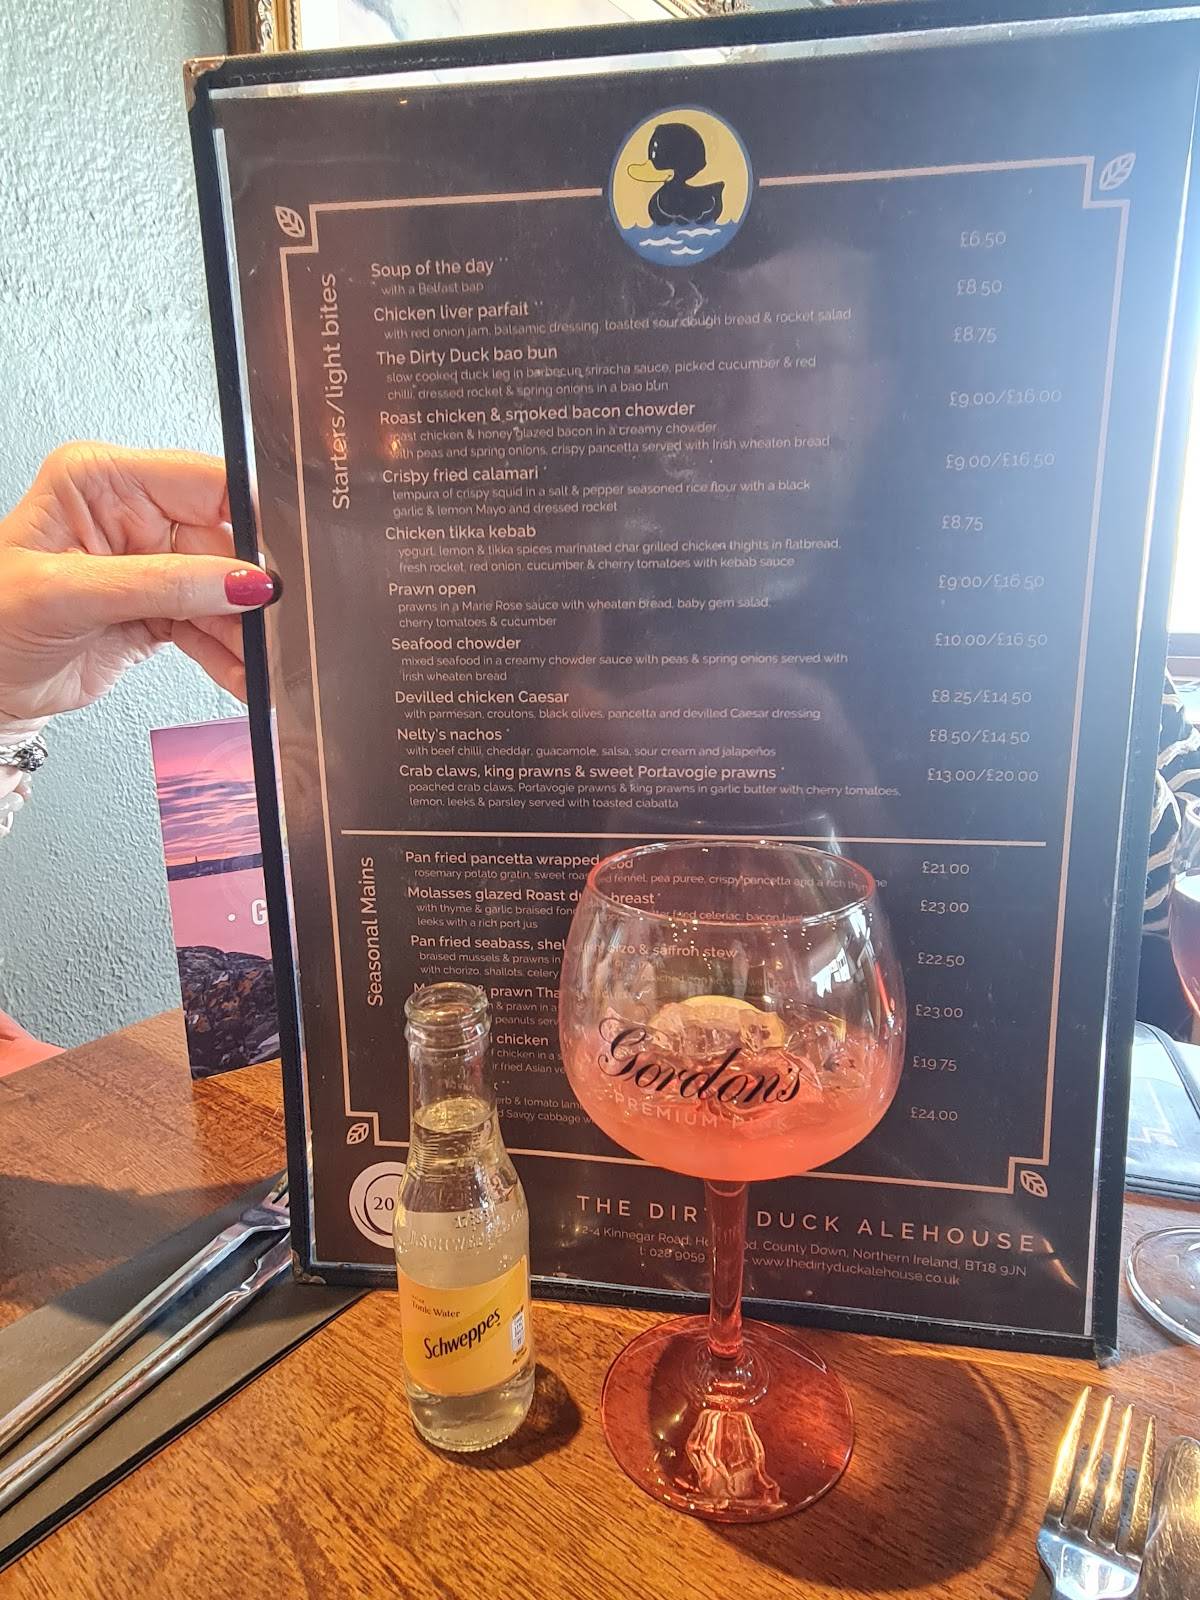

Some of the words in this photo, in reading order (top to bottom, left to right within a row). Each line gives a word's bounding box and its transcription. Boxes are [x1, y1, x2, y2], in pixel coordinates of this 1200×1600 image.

[371, 262, 411, 279] Soup
[415, 260, 430, 275] of
[435, 259, 461, 274] the
[465, 258, 494, 276] day
[381, 284, 405, 296] with
[408, 286, 415, 294] a
[419, 282, 460, 295] Belfast
[462, 282, 484, 293] bap
[321, 273, 340, 336] bites
[374, 307, 435, 322] Chicken
[440, 304, 473, 320] liver
[478, 301, 529, 321] parfait
[376, 351, 406, 365] The
[410, 349, 445, 366] Dirty
[450, 348, 490, 363] Duck
[493, 347, 523, 361] bao
[527, 346, 558, 360] bun
[380, 411, 423, 424] Roast
[427, 408, 485, 424] chicken
[491, 408, 500, 421] &
[505, 406, 568, 421] smoked
[572, 404, 621, 419] bacon
[625, 402, 695, 417] chowder
[324, 342, 350, 509] Starters/light
[382, 469, 429, 485] Crispy
[433, 467, 468, 482] fried
[473, 465, 539, 482] calamari
[393, 503, 423, 518] garlic
[427, 505, 434, 515] &
[438, 503, 472, 515] lemon
[475, 503, 506, 516] Mayo
[509, 503, 531, 514] and
[533, 501, 578, 514] dressed
[581, 500, 618, 512] rocket
[385, 525, 445, 541] Chicken
[449, 524, 485, 539] tikka
[489, 523, 536, 538] kebab
[388, 583, 435, 596] Prawn
[438, 583, 476, 599] open
[399, 616, 433, 630] cherry
[436, 616, 487, 628] tomatoes
[489, 616, 498, 627] &
[500, 616, 556, 627] cucumber
[391, 637, 452, 651] Seafood
[457, 636, 521, 650] chowder
[402, 671, 424, 682] Irish
[426, 671, 472, 681] wheaten
[475, 671, 507, 681] bread
[395, 690, 454, 704] Devilled
[457, 690, 515, 703] chicken
[518, 690, 569, 704] Caesar
[405, 710, 426, 719] with
[539, 709, 567, 719] black
[610, 709, 656, 721] pancetta
[659, 708, 680, 719] and
[683, 708, 727, 719] devilled
[729, 708, 769, 719] Caesar
[772, 708, 821, 721] dressing
[397, 728, 446, 743] Nelty's
[450, 728, 502, 741] nachos
[399, 765, 433, 777] Crab
[436, 764, 481, 779] claws,
[484, 765, 514, 780] king
[518, 766, 571, 780] prawns
[575, 766, 585, 778] &
[590, 766, 634, 778] sweet
[638, 765, 718, 780] Portavogie
[721, 767, 777, 780] prawns
[408, 783, 455, 794] poached
[457, 783, 480, 792] crab
[518, 783, 574, 794] Portavogie
[577, 785, 617, 794] prawns
[620, 783, 627, 793] &
[630, 784, 653, 795] king
[656, 784, 695, 795] prawns
[698, 783, 708, 793] in
[710, 784, 740, 796] garlic
[743, 785, 777, 794] butter
[780, 785, 804, 795] with
[807, 785, 841, 797] cherry
[447, 797, 476, 807] leeks
[478, 797, 486, 807] &
[488, 797, 526, 809] parsley
[528, 798, 564, 807] served
[567, 798, 590, 807] with
[592, 798, 632, 808] toasted
[635, 798, 678, 809] ciabatta
[406, 851, 431, 863] Pan
[434, 851, 467, 864] fried
[471, 853, 533, 867] pancetta
[536, 854, 600, 868] wrapped
[922, 861, 970, 875] £21.00
[359, 857, 377, 914] Mains
[407, 887, 471, 899] Molasses
[475, 888, 523, 902] glazed
[527, 889, 565, 901] Roast
[610, 892, 654, 904] breast
[920, 900, 969, 914] £23.00
[417, 918, 444, 927] leeks
[444, 918, 468, 927] with
[471, 919, 476, 927] a
[479, 918, 498, 928] rich
[500, 919, 520, 929] port
[522, 919, 538, 929] jus
[411, 935, 436, 947] Pan
[439, 935, 471, 948] fried
[474, 937, 534, 951] seabass,
[639, 944, 649, 954] &
[652, 943, 700, 956] saffron
[703, 948, 737, 958] stew
[361, 919, 383, 1006] Seasonal
[918, 952, 965, 967] £22.50
[491, 987, 532, 998] prawn
[536, 987, 559, 998] Tha
[915, 1004, 963, 1019] £23.00
[496, 1034, 549, 1047] chicken
[597, 1017, 803, 1104] Gordon's
[614, 1091, 717, 1128] PREMIUM
[911, 1107, 958, 1121] £24.00
[576, 1195, 631, 1217] THE
[650, 1203, 707, 1223] DIR
[757, 1211, 840, 1233] DUCK
[857, 1219, 1034, 1252] ALEHOUSE
[582, 1225, 600, 1236] 2-4
[603, 1227, 655, 1242] Kinnegar
[763, 1241, 806, 1255] County
[852, 1249, 910, 1264] Northern
[965, 1260, 997, 1273] BT18
[1000, 1265, 1027, 1277] 9JN
[649, 1249, 672, 1257] 028
[674, 1251, 706, 1263] 9059
[752, 1256, 960, 1286] www.thedirtyduckalehouse.co.uk
[433, 1308, 460, 1318] Water
[423, 1308, 501, 1359] Schweppes
